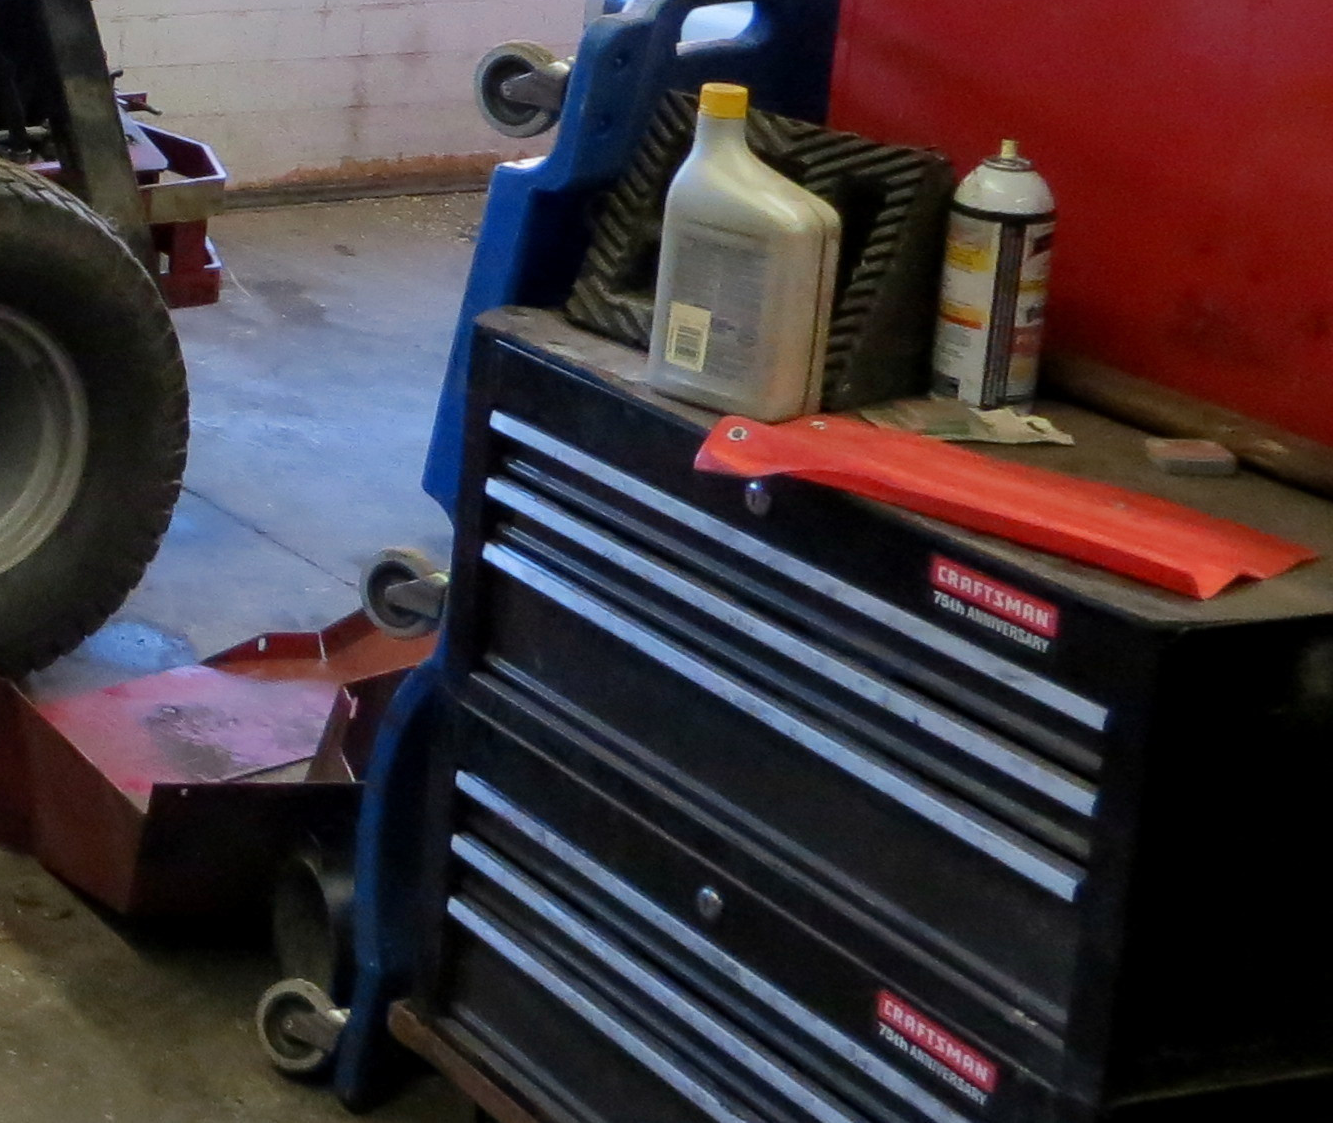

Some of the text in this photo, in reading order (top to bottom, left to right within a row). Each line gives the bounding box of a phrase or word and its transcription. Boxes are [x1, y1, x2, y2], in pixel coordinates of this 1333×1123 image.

[933, 590, 1051, 653] 75th ANNIVERSARY
[937, 565, 1050, 628] CRAFTSMAN
[878, 1021, 989, 1106] 75th ANNIVERSARY
[884, 1000, 990, 1082] CRAFTSMAN
